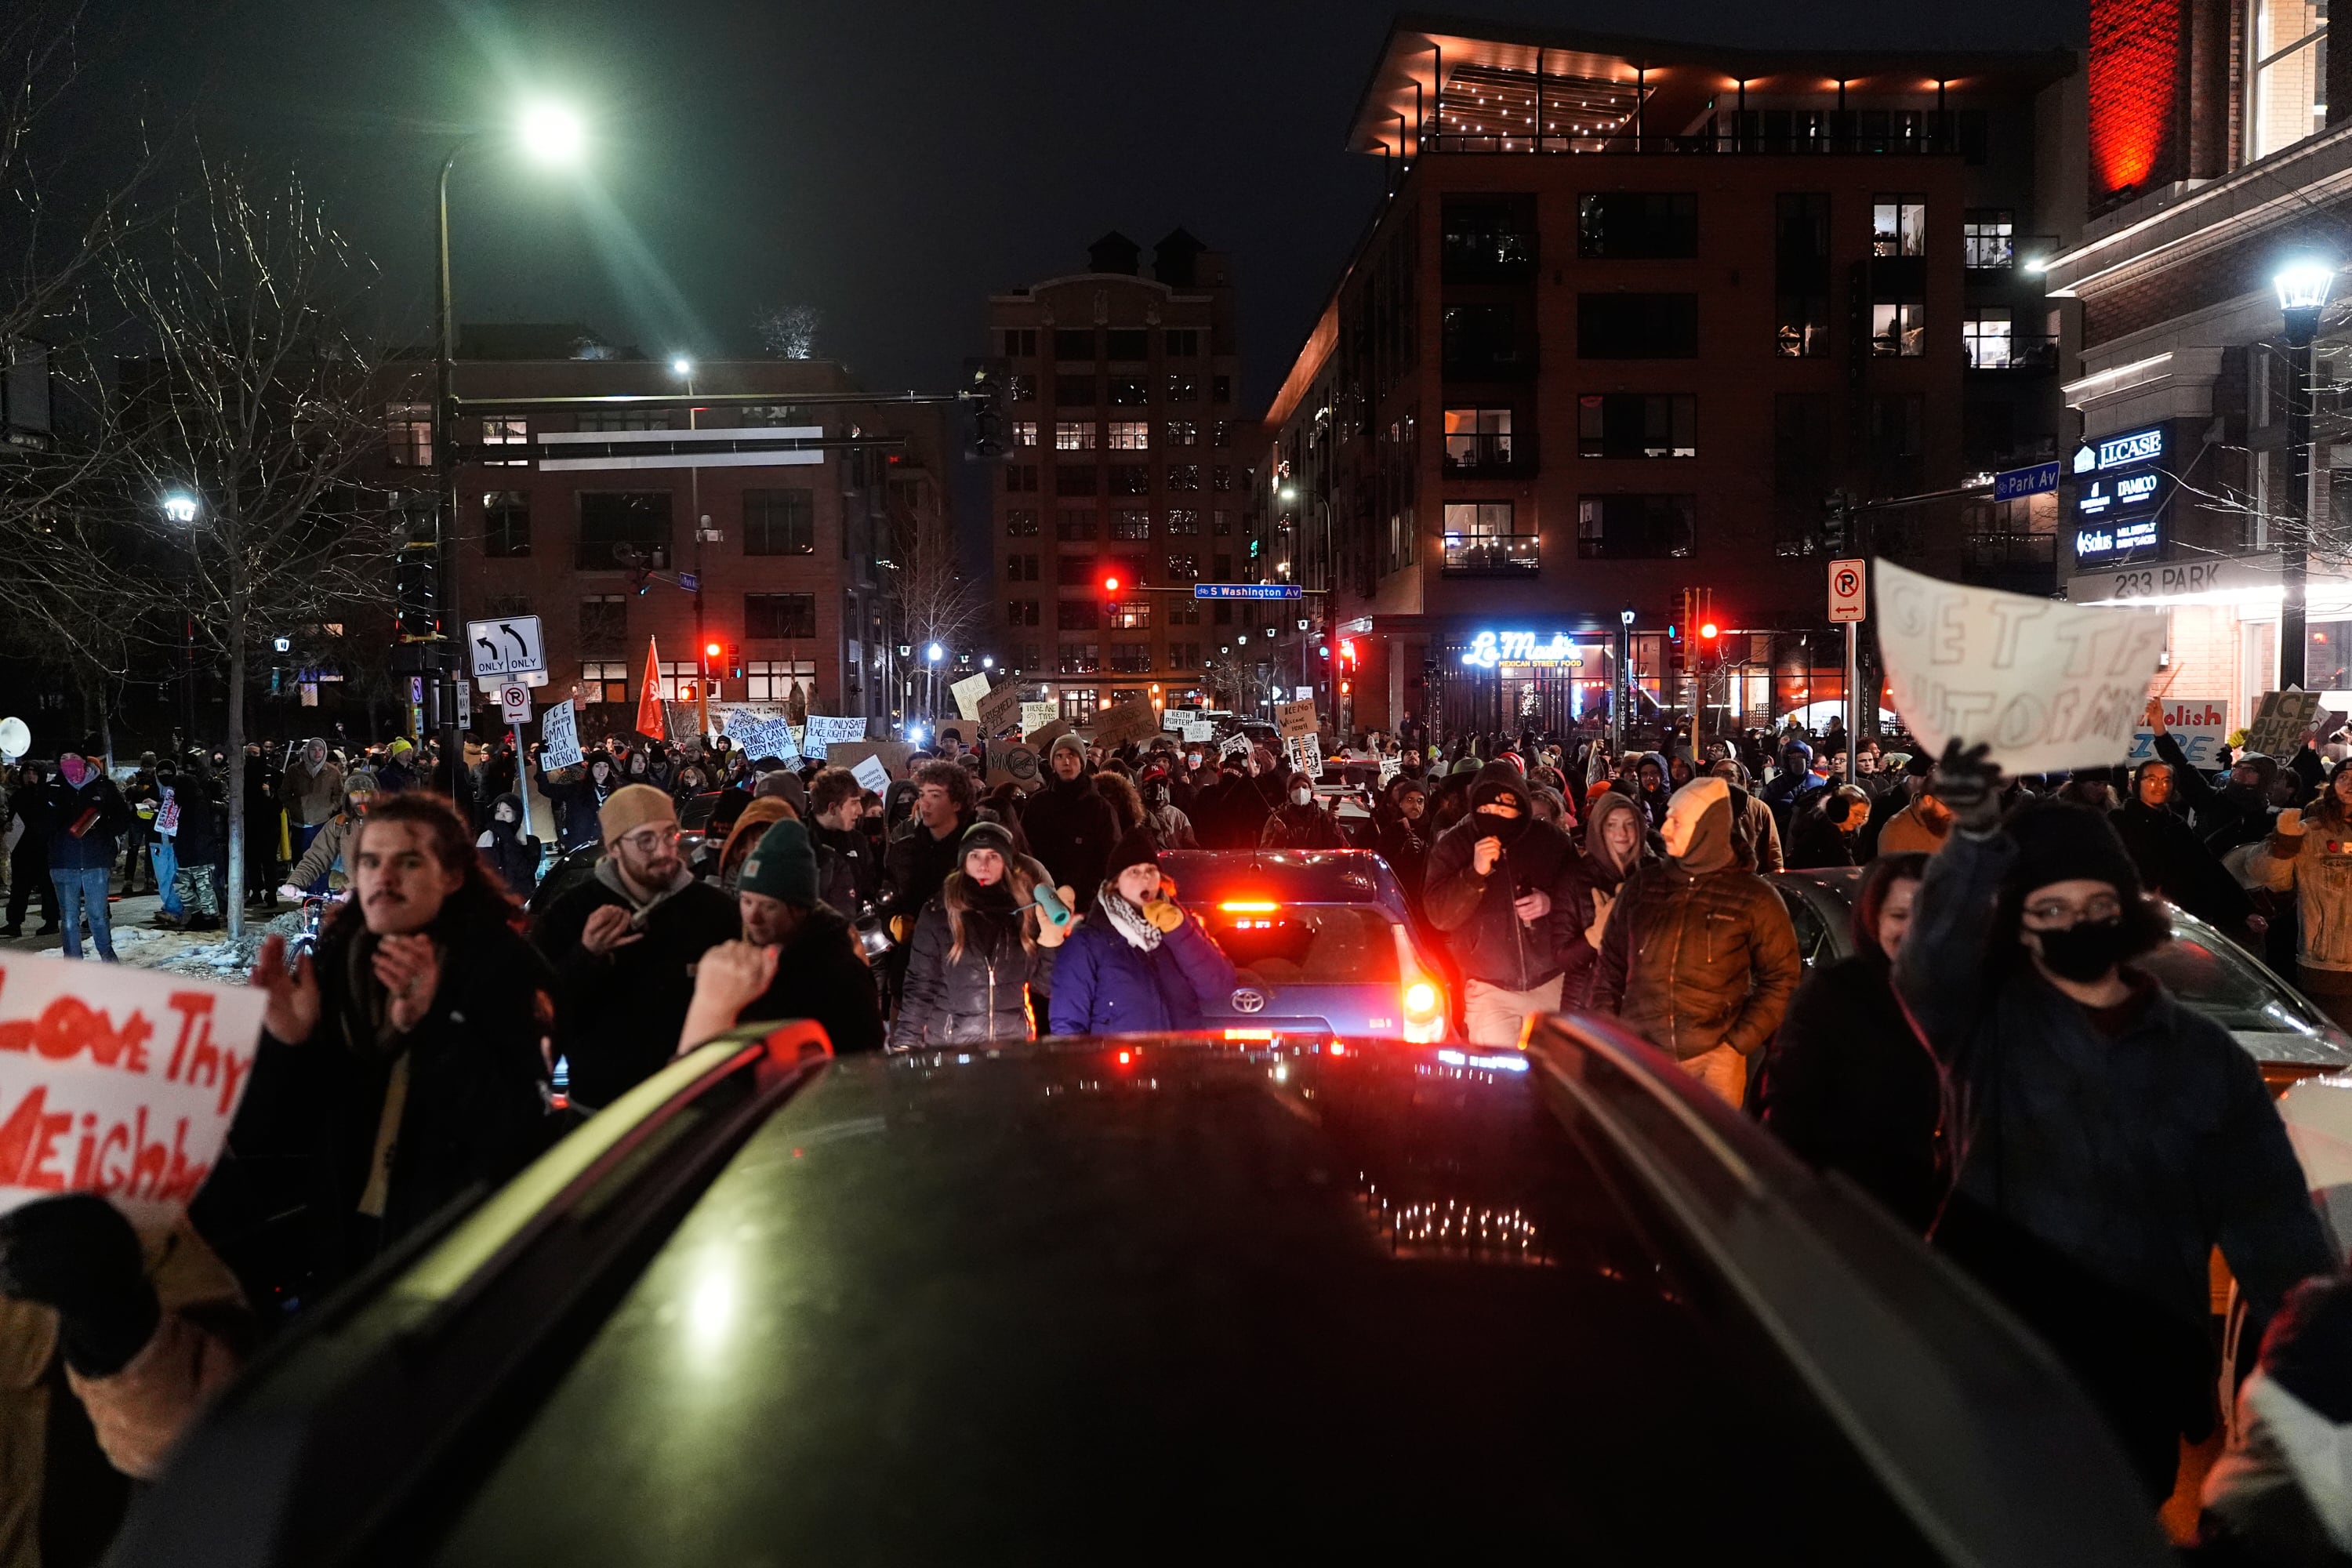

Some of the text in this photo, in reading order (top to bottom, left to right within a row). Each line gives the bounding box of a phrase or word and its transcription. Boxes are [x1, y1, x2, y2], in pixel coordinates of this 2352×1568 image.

[2009, 470, 2056, 494] Park Av
[2114, 563, 2220, 598] 233 PARK
[1210, 587, 1218, 596] S
[1221, 587, 1281, 599] Washington
[479, 658, 536, 672] ONLY ONLY
[459, 684, 468, 695] ONE
[958, 677, 985, 694] ICE
[459, 698, 468, 709] WAY
[981, 697, 1013, 724] CRUSHED
[1044, 704, 1057, 713] ARE
[2260, 693, 2321, 720] ICE
[545, 702, 568, 723] ICE
[739, 716, 786, 737] YOUR SIGNING
[809, 717, 827, 728] THE
[1026, 713, 1037, 727] 2
[1165, 717, 1193, 727] PORTER!
[544, 724, 575, 744] SMALL
[742, 732, 765, 747] BONUS
[806, 727, 863, 738] PLACE RIGHT NOW
[548, 739, 569, 755] DICK
[746, 743, 768, 758] REPAY
[769, 738, 795, 752] MORAL
[805, 746, 827, 759] EPSTE
[543, 751, 579, 769] ENERGY
[858, 768, 880, 781] families
[862, 775, 882, 787] belong
[869, 778, 887, 791] gether
[166, 990, 252, 1116] Thy
